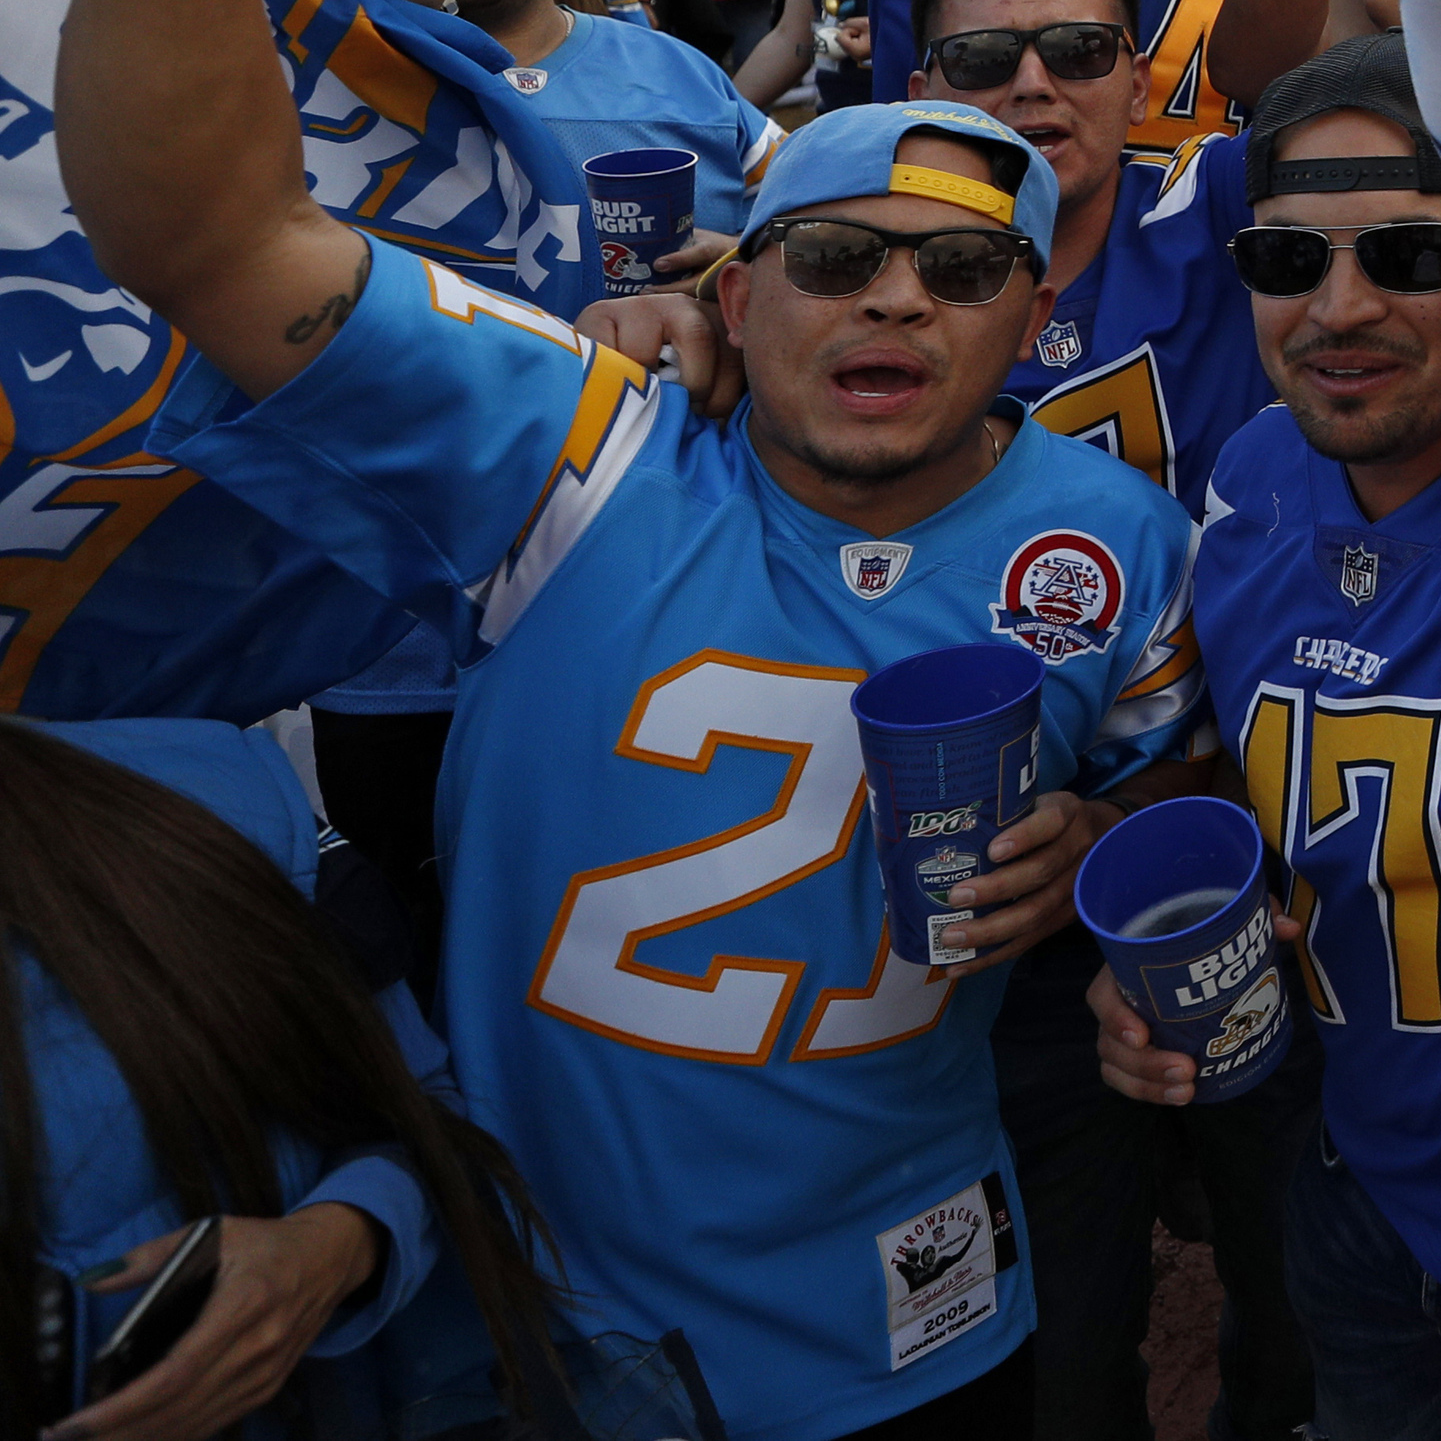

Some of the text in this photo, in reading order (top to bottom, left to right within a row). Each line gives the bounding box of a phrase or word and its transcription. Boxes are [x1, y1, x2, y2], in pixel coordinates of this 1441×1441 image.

[591, 197, 642, 219] BUD
[604, 281, 654, 295] CHIEF
[1046, 340, 1076, 361] NFL
[850, 548, 906, 560] EQUIPMENT
[860, 570, 885, 588] NFL
[1346, 566, 1371, 597] NFL
[1015, 622, 1092, 646] ANNIVERSARY SEASON
[923, 869, 973, 886] MEXICO
[1187, 906, 1266, 985] BUD
[1175, 908, 1274, 1008] LIGHT
[890, 1207, 982, 1267] THROWBACKS
[923, 1299, 970, 1335] 2009
